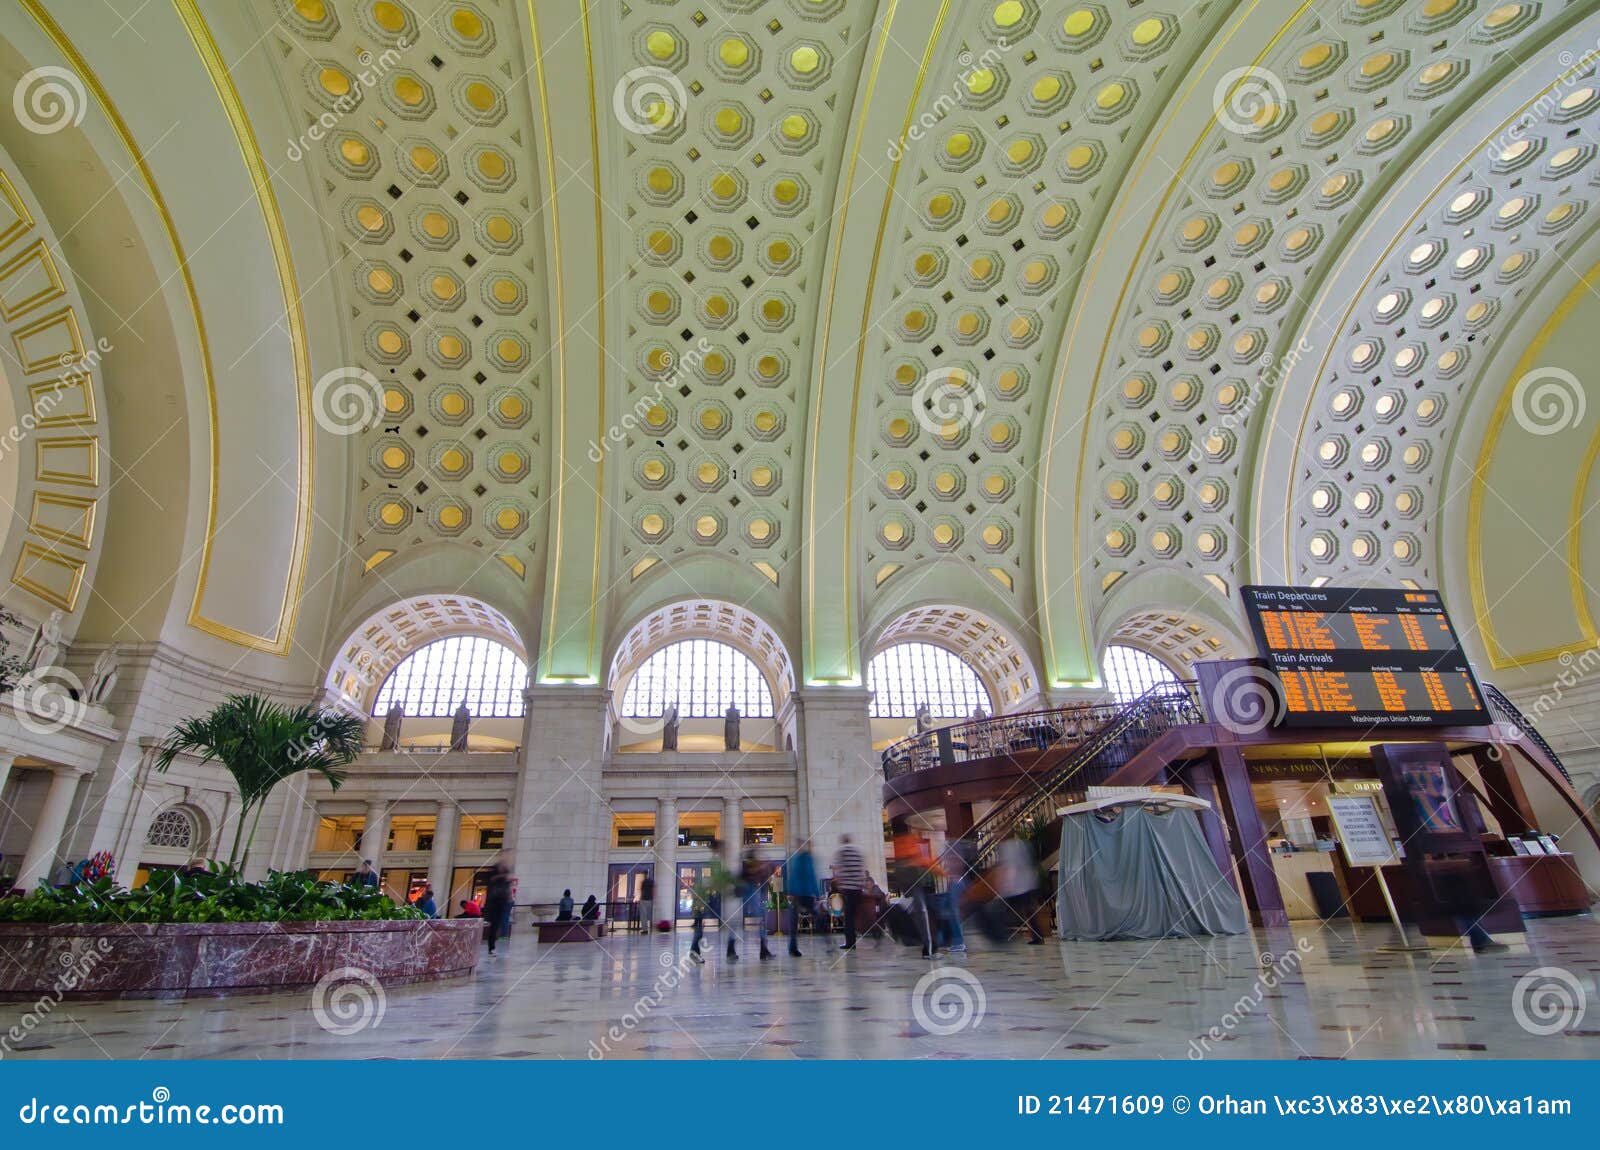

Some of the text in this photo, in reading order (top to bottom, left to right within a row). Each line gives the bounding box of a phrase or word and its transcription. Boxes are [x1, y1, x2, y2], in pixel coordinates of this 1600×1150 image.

[1252, 590, 1328, 602] Train Departures
[1272, 653, 1334, 663] Train Arrivals
[1350, 715, 1433, 724] Washington Union Station
[1252, 763, 1350, 774] NEWS INFORION
